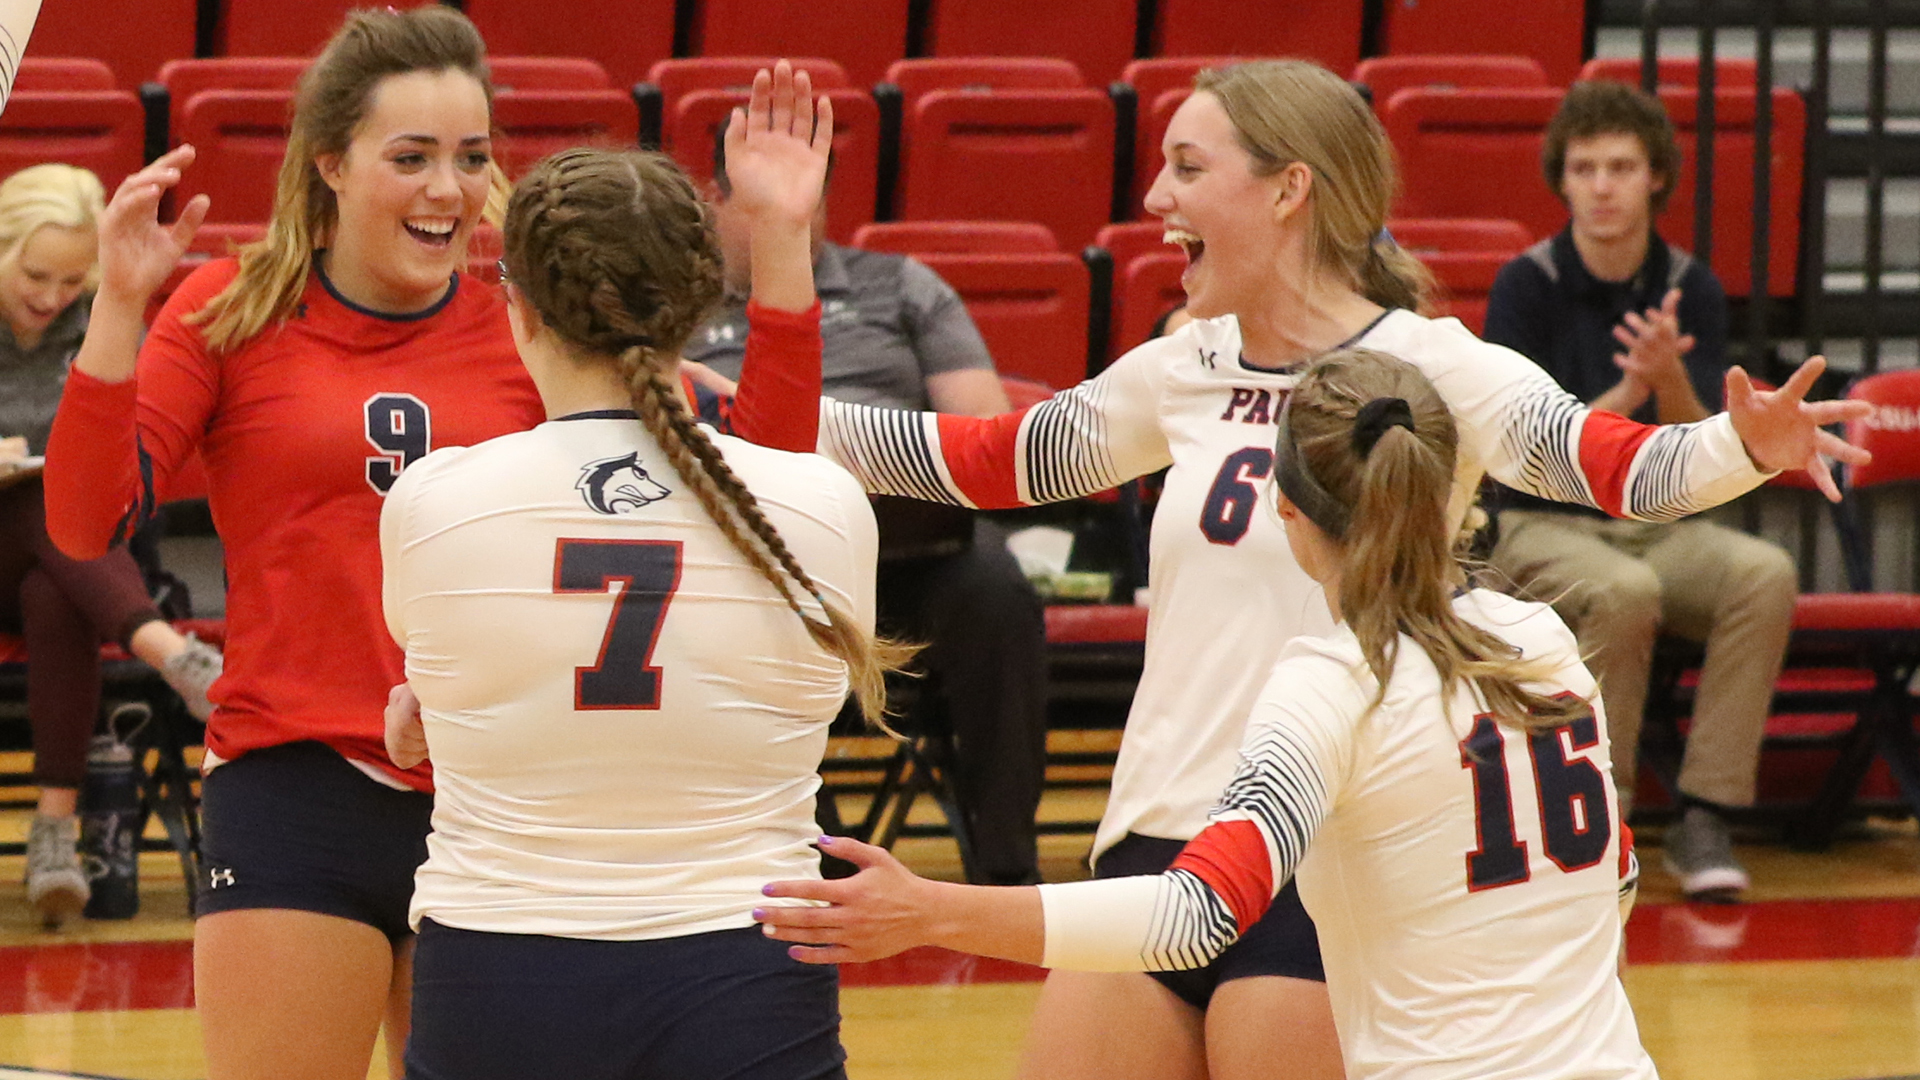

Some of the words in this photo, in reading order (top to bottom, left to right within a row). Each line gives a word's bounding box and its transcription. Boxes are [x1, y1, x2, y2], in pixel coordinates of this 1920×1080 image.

[363, 391, 431, 496] 9
[1201, 447, 1275, 547] 6
[553, 537, 684, 711] 7
[1459, 689, 1611, 893] 16
